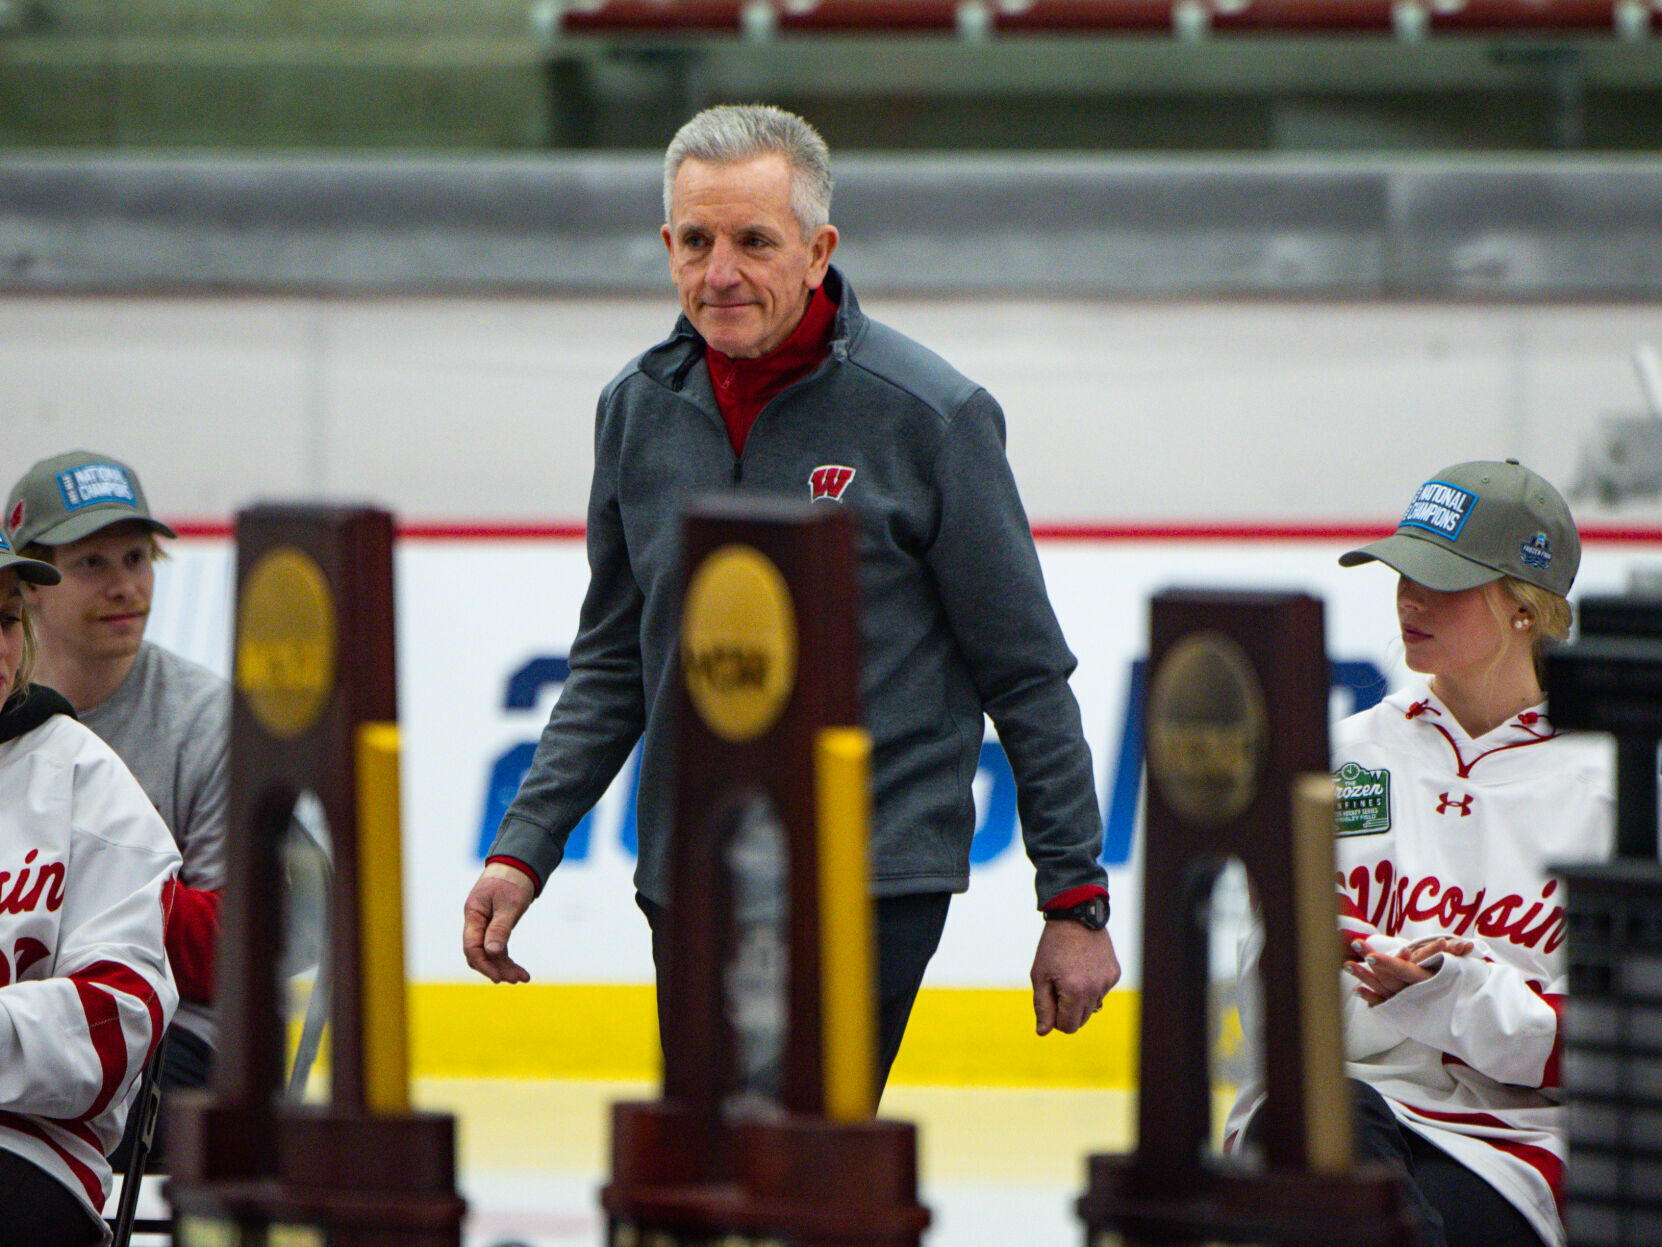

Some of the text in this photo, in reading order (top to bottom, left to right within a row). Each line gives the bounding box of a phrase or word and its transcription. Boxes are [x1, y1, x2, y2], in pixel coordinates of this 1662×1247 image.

[808, 465, 856, 503] W
[1419, 484, 1467, 513] NATIONAL
[1407, 501, 1460, 531] CHAMPIONS
[1333, 783, 1383, 799] rozen
